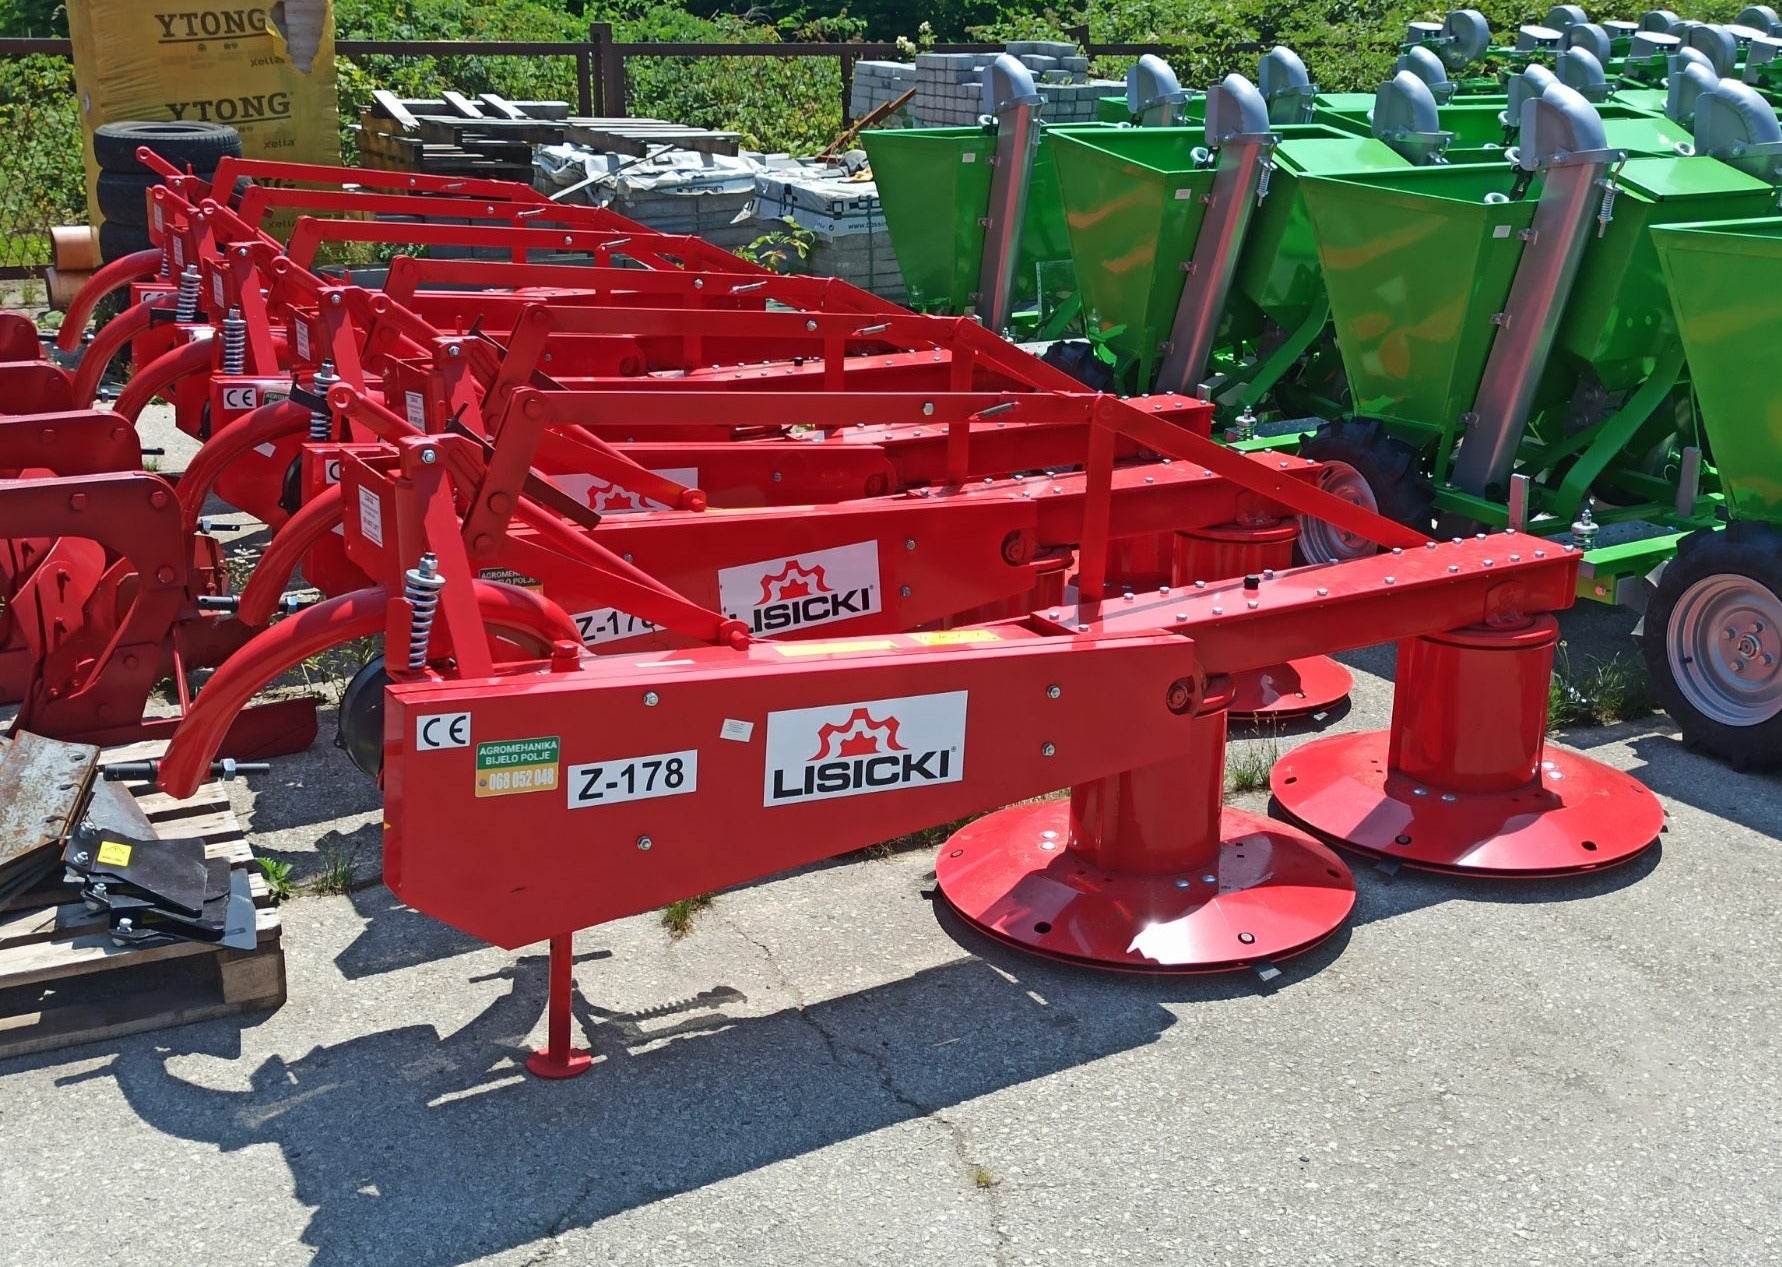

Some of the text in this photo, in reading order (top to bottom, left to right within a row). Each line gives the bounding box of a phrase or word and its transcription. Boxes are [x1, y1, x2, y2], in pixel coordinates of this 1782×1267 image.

[155, 8, 266, 37] YTONG
[165, 92, 290, 121] YTONG
[729, 587, 870, 634] ISICKI
[423, 715, 467, 747] CE
[480, 740, 557, 755] AGROMEHANIKA
[485, 751, 551, 765] BIJELO POLJE
[489, 767, 554, 791] 068 052 048
[578, 758, 684, 800] Z-178
[773, 750, 950, 799] LISICKI
